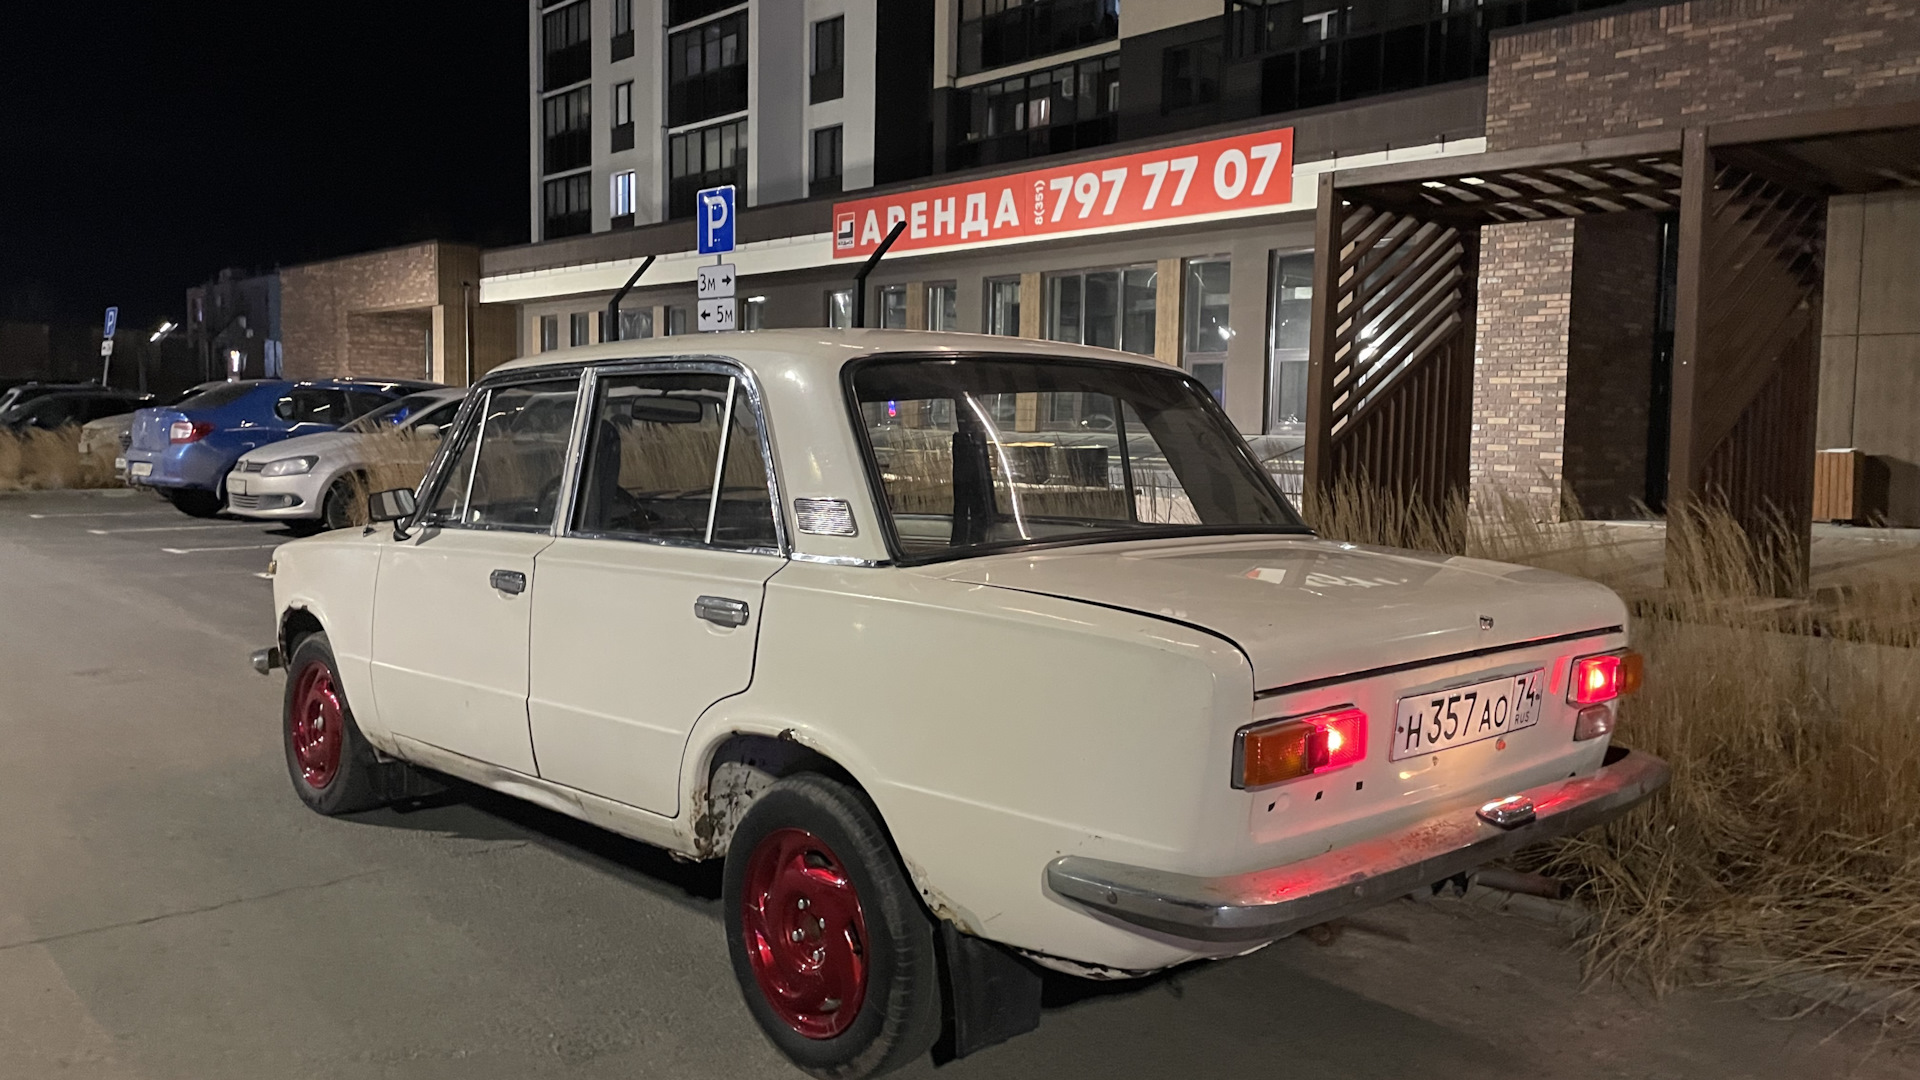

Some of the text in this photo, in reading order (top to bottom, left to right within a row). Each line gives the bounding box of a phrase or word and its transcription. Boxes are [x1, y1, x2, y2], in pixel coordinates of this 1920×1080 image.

[860, 142, 1282, 246] АРЕНДА 8(351) 797 77 07
[704, 195, 728, 248] P
[1516, 675, 1536, 711] 74
[1514, 711, 1530, 725] RUS
